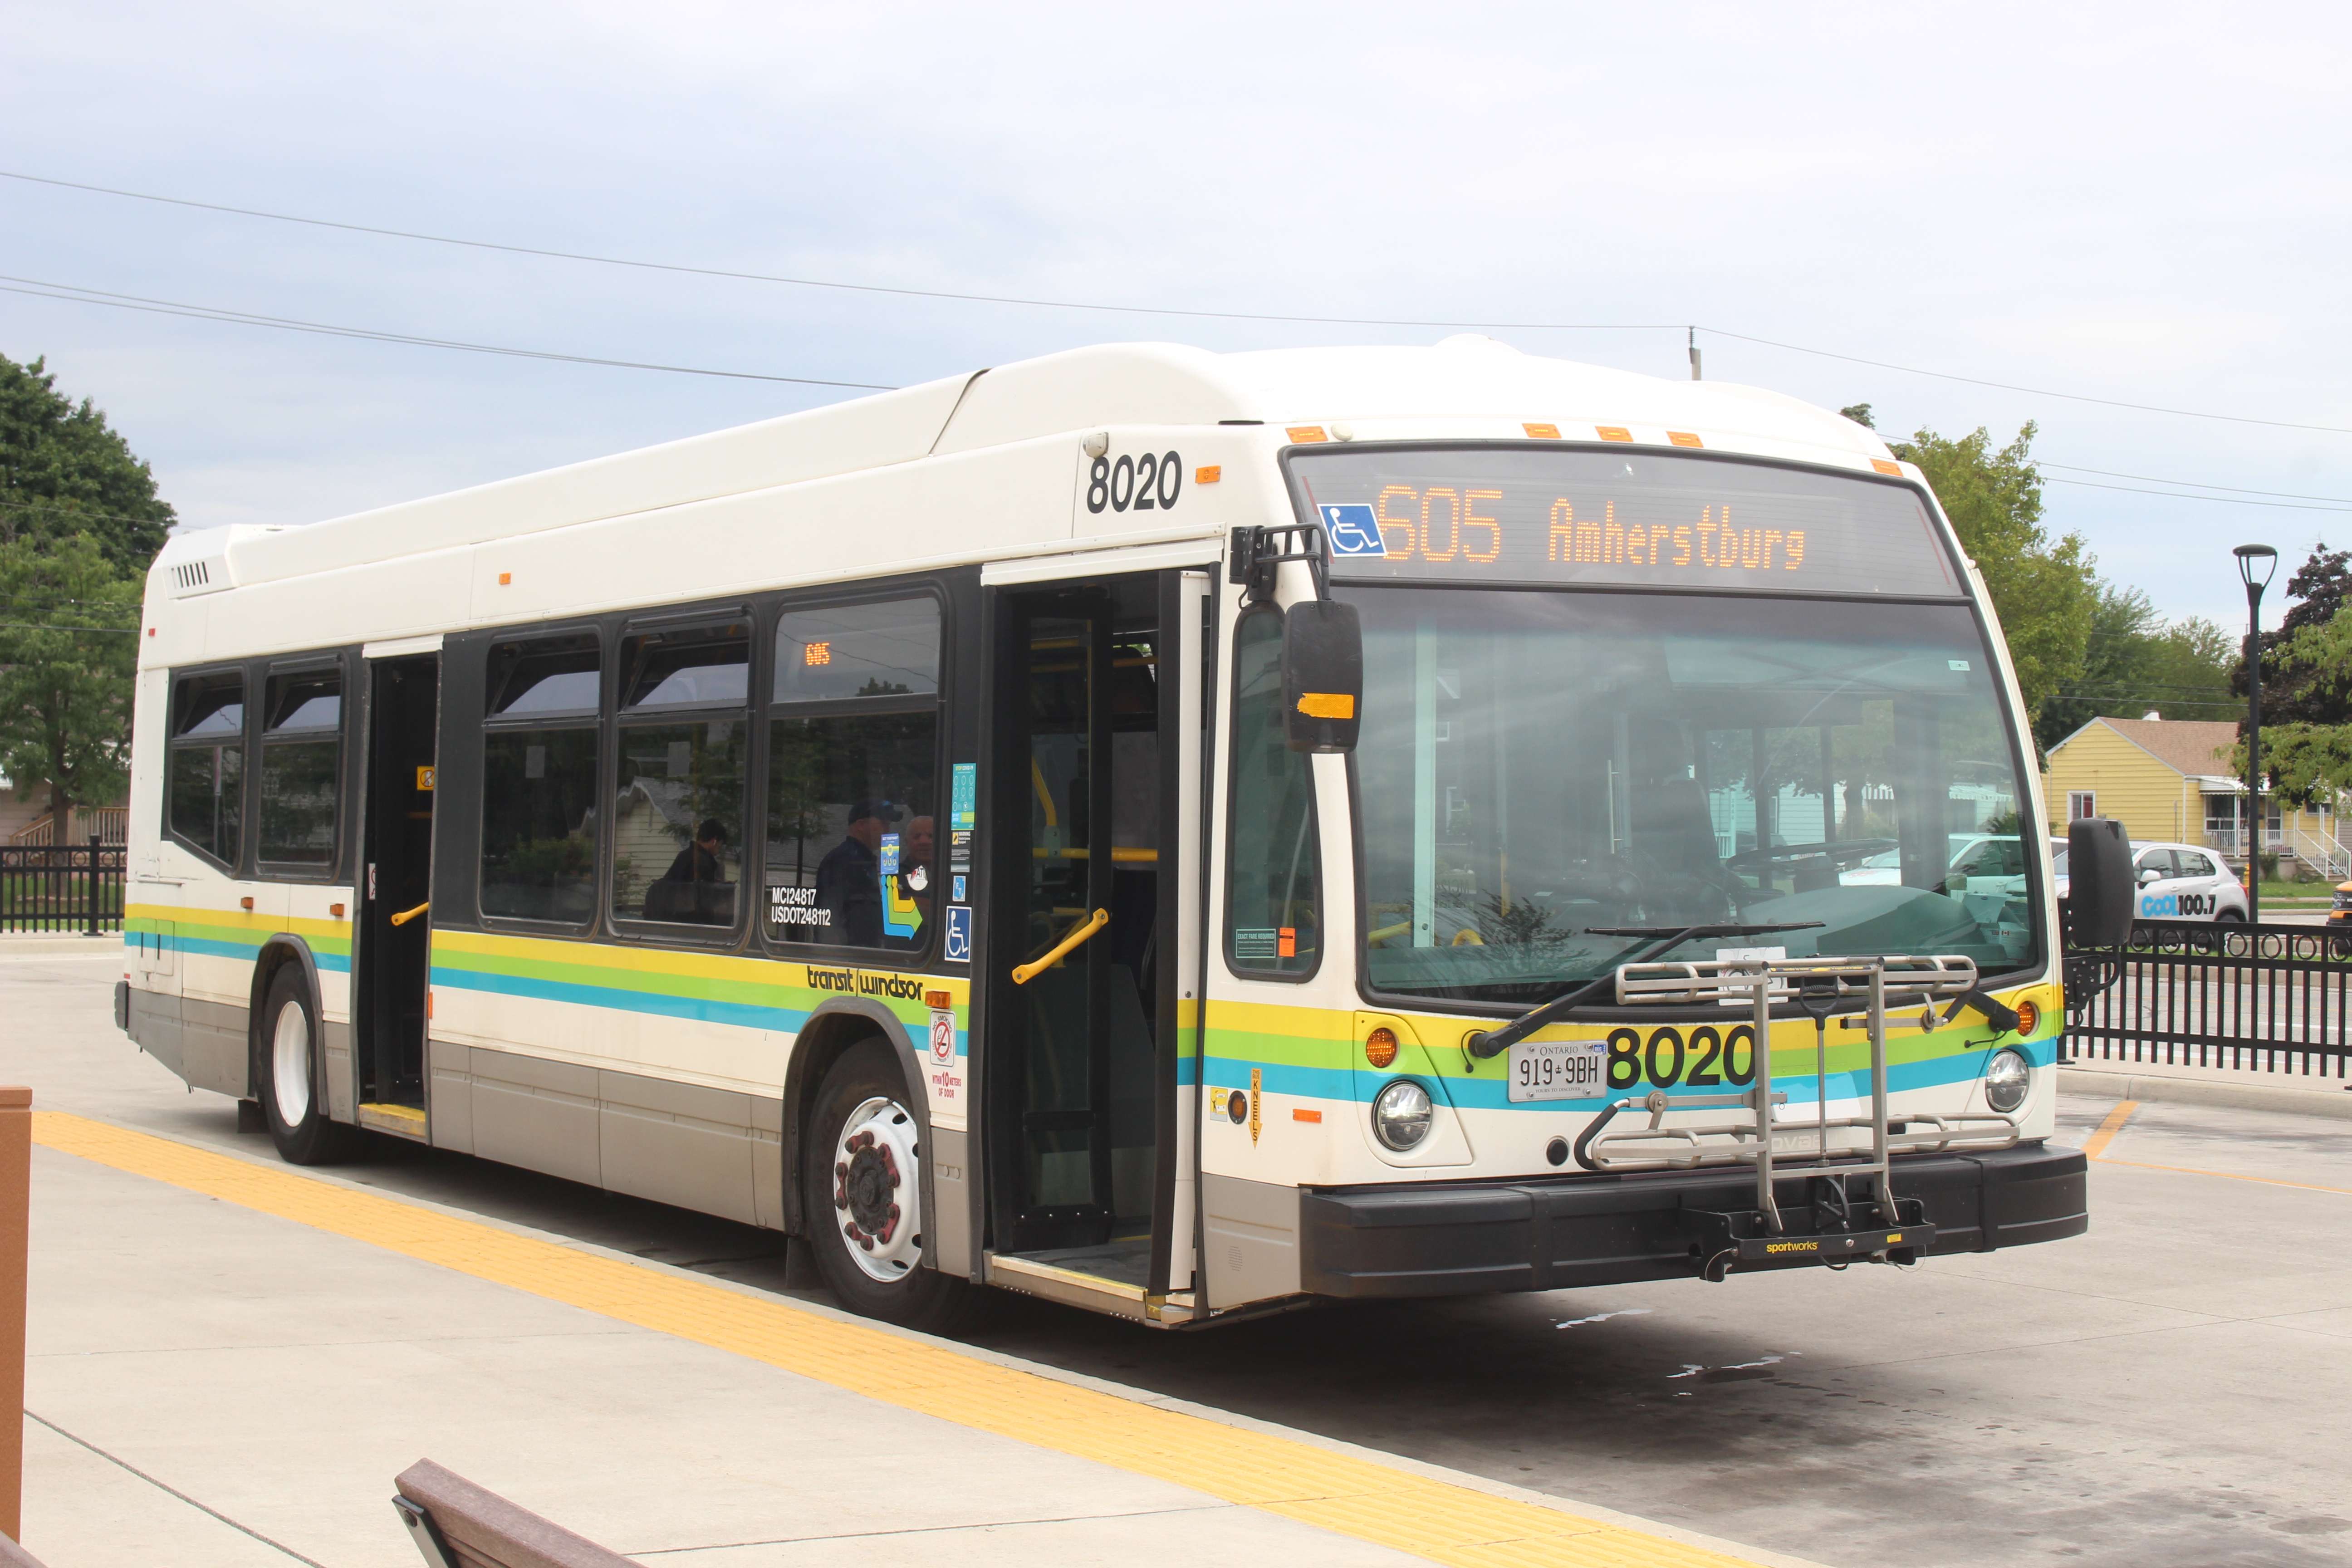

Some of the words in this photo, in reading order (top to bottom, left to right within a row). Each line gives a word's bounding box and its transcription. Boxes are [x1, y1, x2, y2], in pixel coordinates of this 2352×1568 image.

[1087, 450, 1182, 514] 8020
[1377, 485, 1502, 563] 605
[1549, 498, 1805, 570] Amherstburg
[805, 642, 831, 666] 605
[772, 887, 816, 905] MCI24817
[2178, 894, 2216, 916] 100.7
[771, 906, 831, 926] USDOT248112
[807, 965, 854, 992] transit
[859, 974, 923, 1001] windsor
[933, 1020, 937, 1031] NO
[938, 1015, 952, 1033] SMOKING
[1540, 1046, 1578, 1056] ONTARIO
[1607, 1025, 1756, 1090] 8020
[932, 1074, 942, 1085] WITHIN
[942, 1071, 949, 1087] 10
[950, 1077, 961, 1086] METERS
[1520, 1058, 1553, 1086] 919
[1566, 1056, 1598, 1083] 9BH
[938, 1088, 943, 1096] OF
[944, 1088, 954, 1098] DOOR
[1766, 1241, 1817, 1254] sportworks
